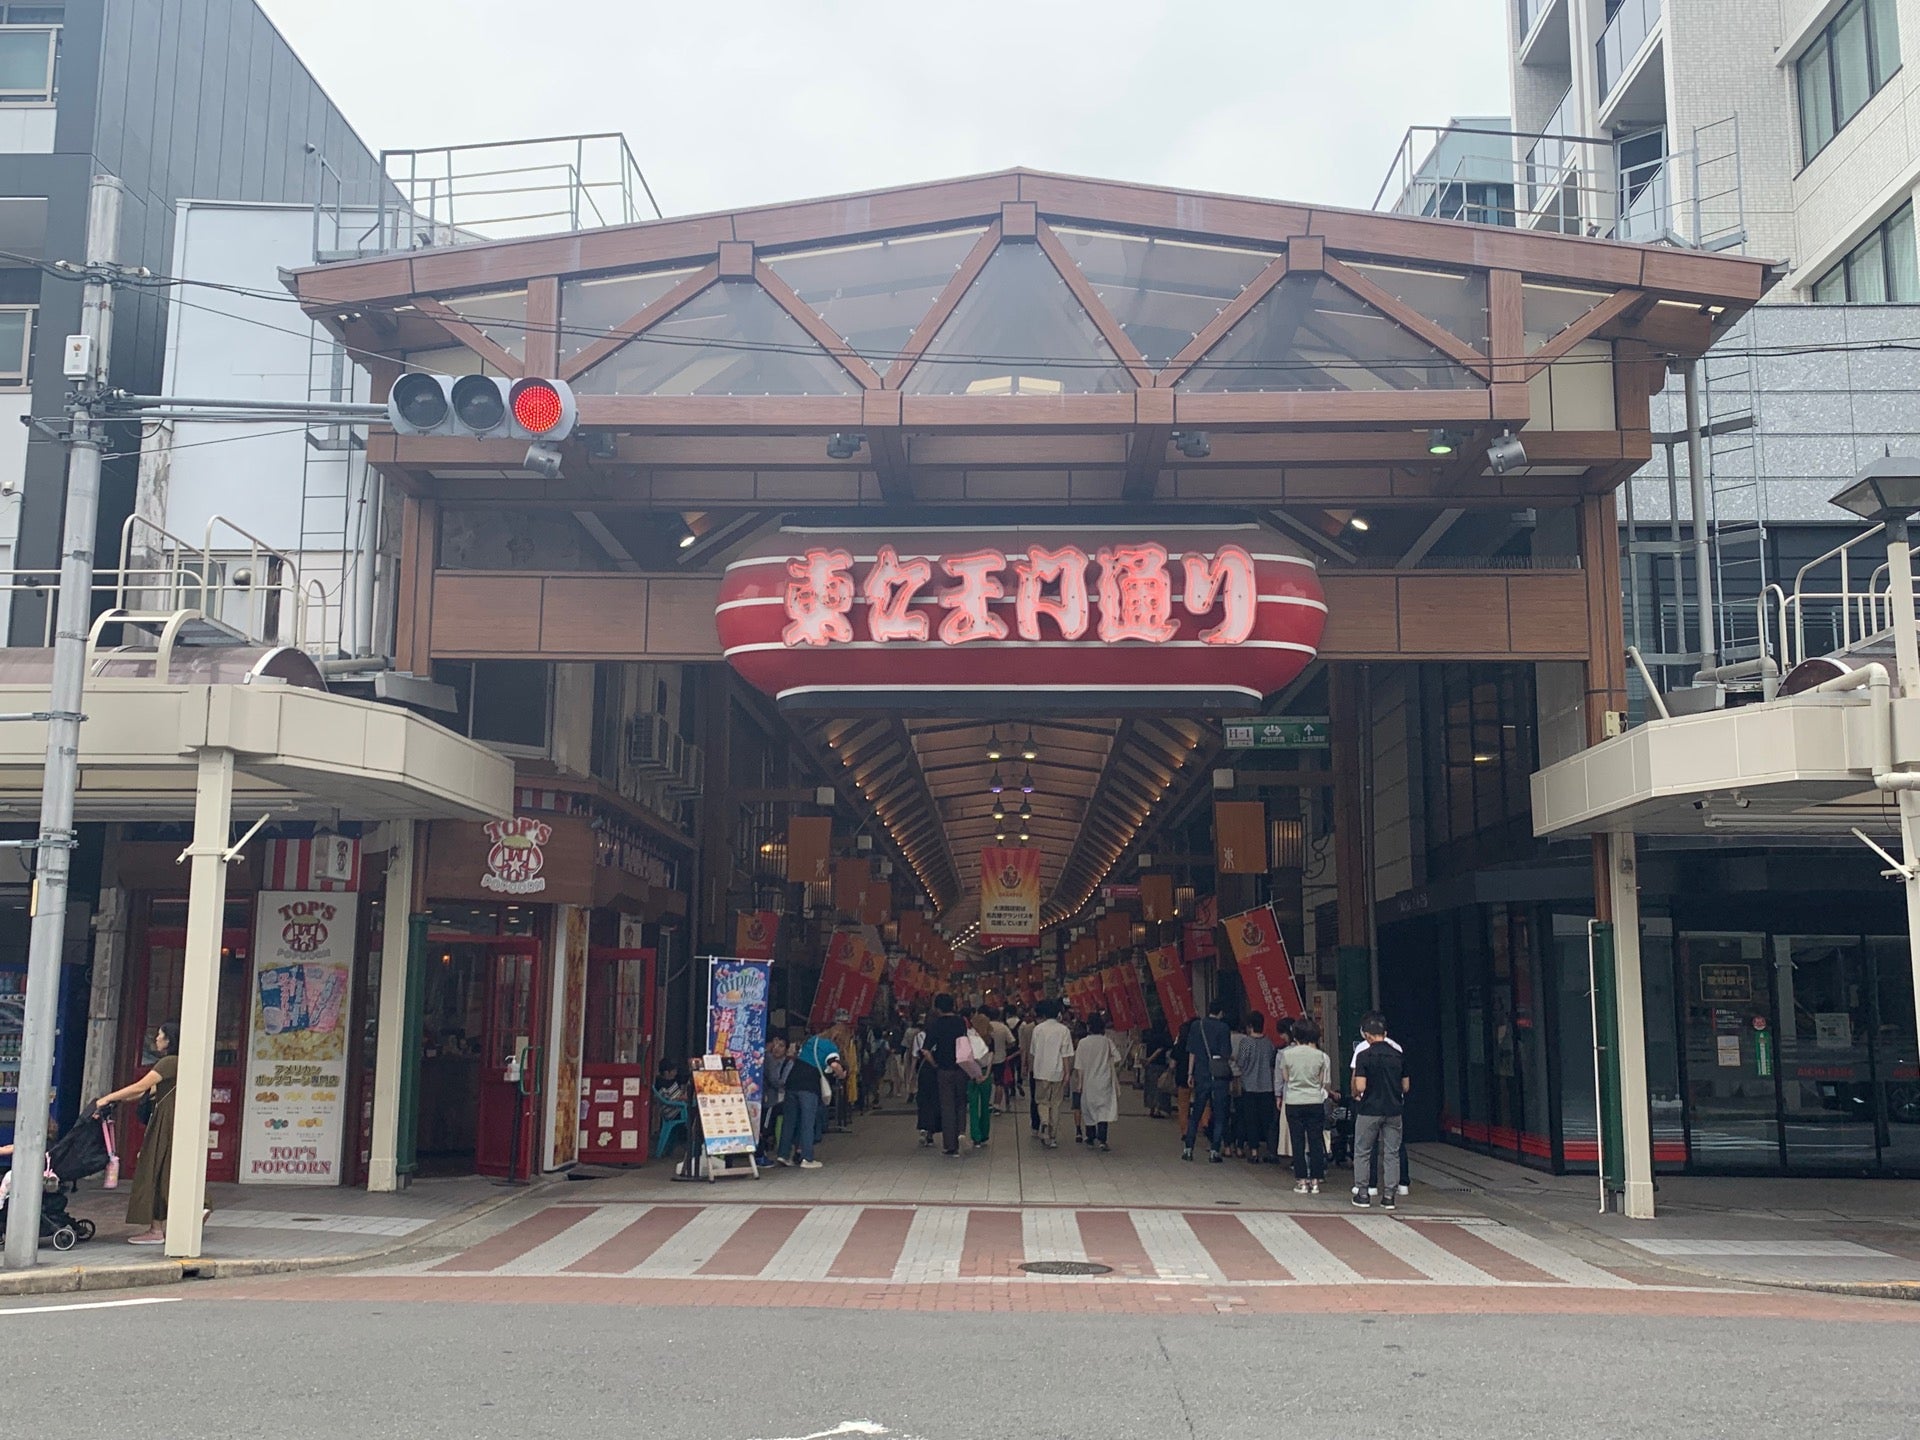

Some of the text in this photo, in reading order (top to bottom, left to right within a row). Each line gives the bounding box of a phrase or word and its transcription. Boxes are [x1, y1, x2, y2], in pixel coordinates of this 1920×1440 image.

[485, 817, 552, 845] TOP'S
[481, 874, 545, 894] POPCORN
[278, 901, 337, 921] TOP'S
[275, 1065, 322, 1075] アメリカン
[255, 1075, 340, 1087] ポップコーン専門店
[269, 1145, 318, 1160] TOP'S
[251, 1160, 332, 1175] POPCORN
